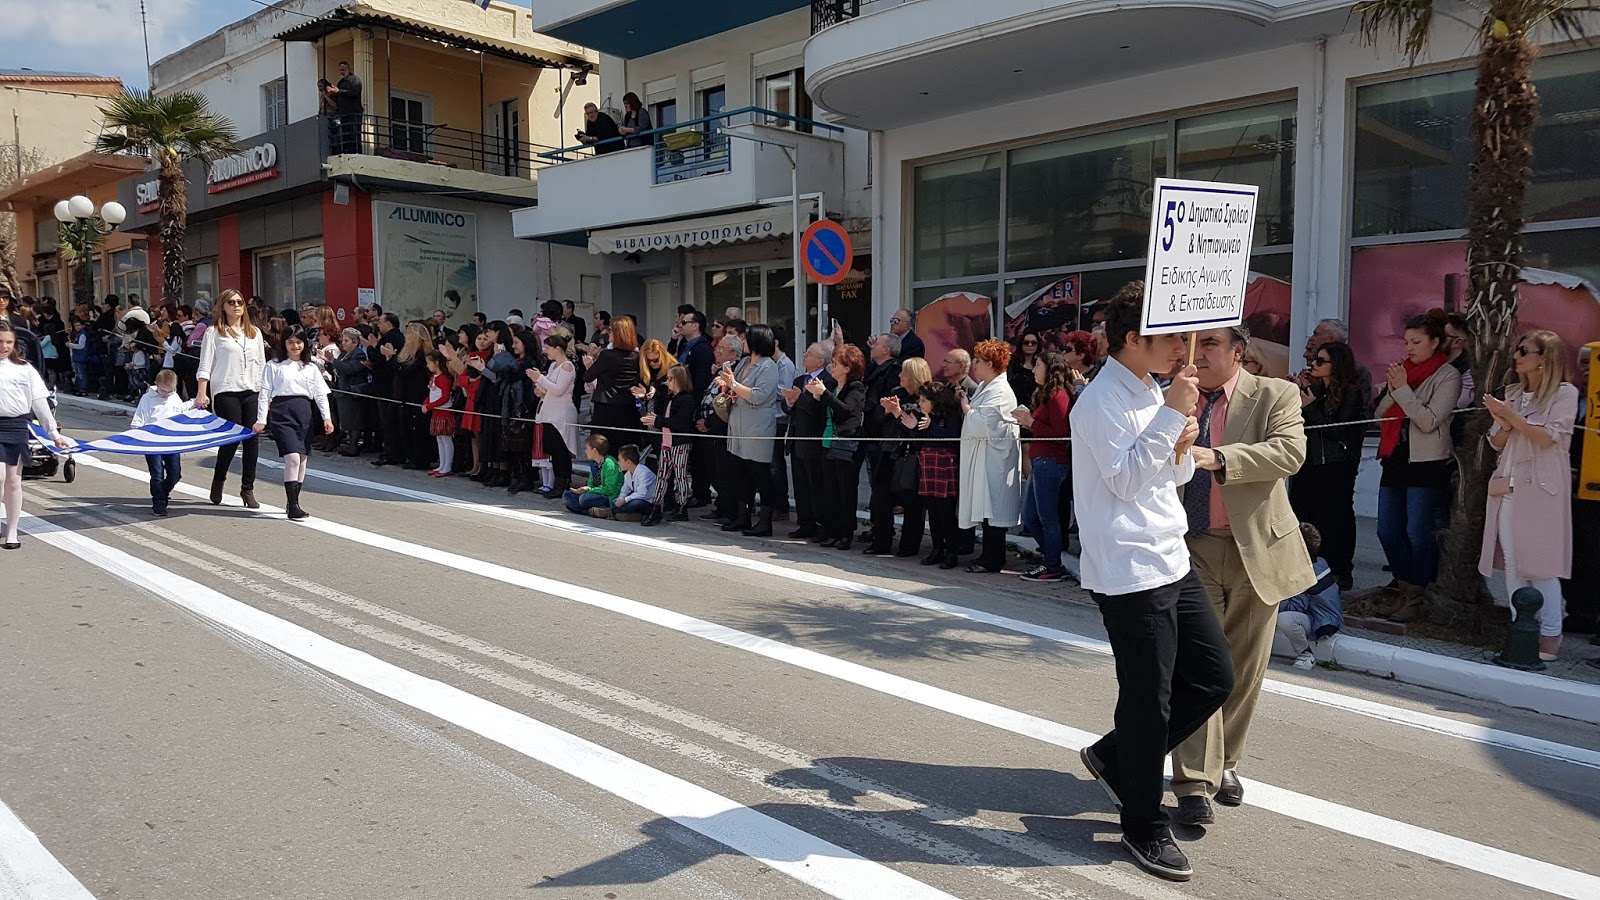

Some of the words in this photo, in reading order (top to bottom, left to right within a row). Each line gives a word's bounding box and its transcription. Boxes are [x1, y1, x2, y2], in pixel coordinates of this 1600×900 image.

[206, 142, 277, 185] ALUMINCO
[388, 206, 465, 228] ALUMINCO
[1188, 201, 1224, 228] Δημοτικό
[1223, 202, 1249, 229] Σχολείο
[615, 221, 773, 249] ΒΙΒΛΙΟΧΑΡΤΟΠΩΛΕΙΟ
[1188, 233, 1195, 254] &
[1196, 233, 1241, 259] Νηπιαγωγείο
[1161, 266, 1198, 288] Ειδικής
[1198, 265, 1233, 287] Αγωγής
[841, 290, 857, 299] FAX
[1168, 294, 1176, 313] &
[1179, 292, 1236, 313] Εκπαίδευσης
